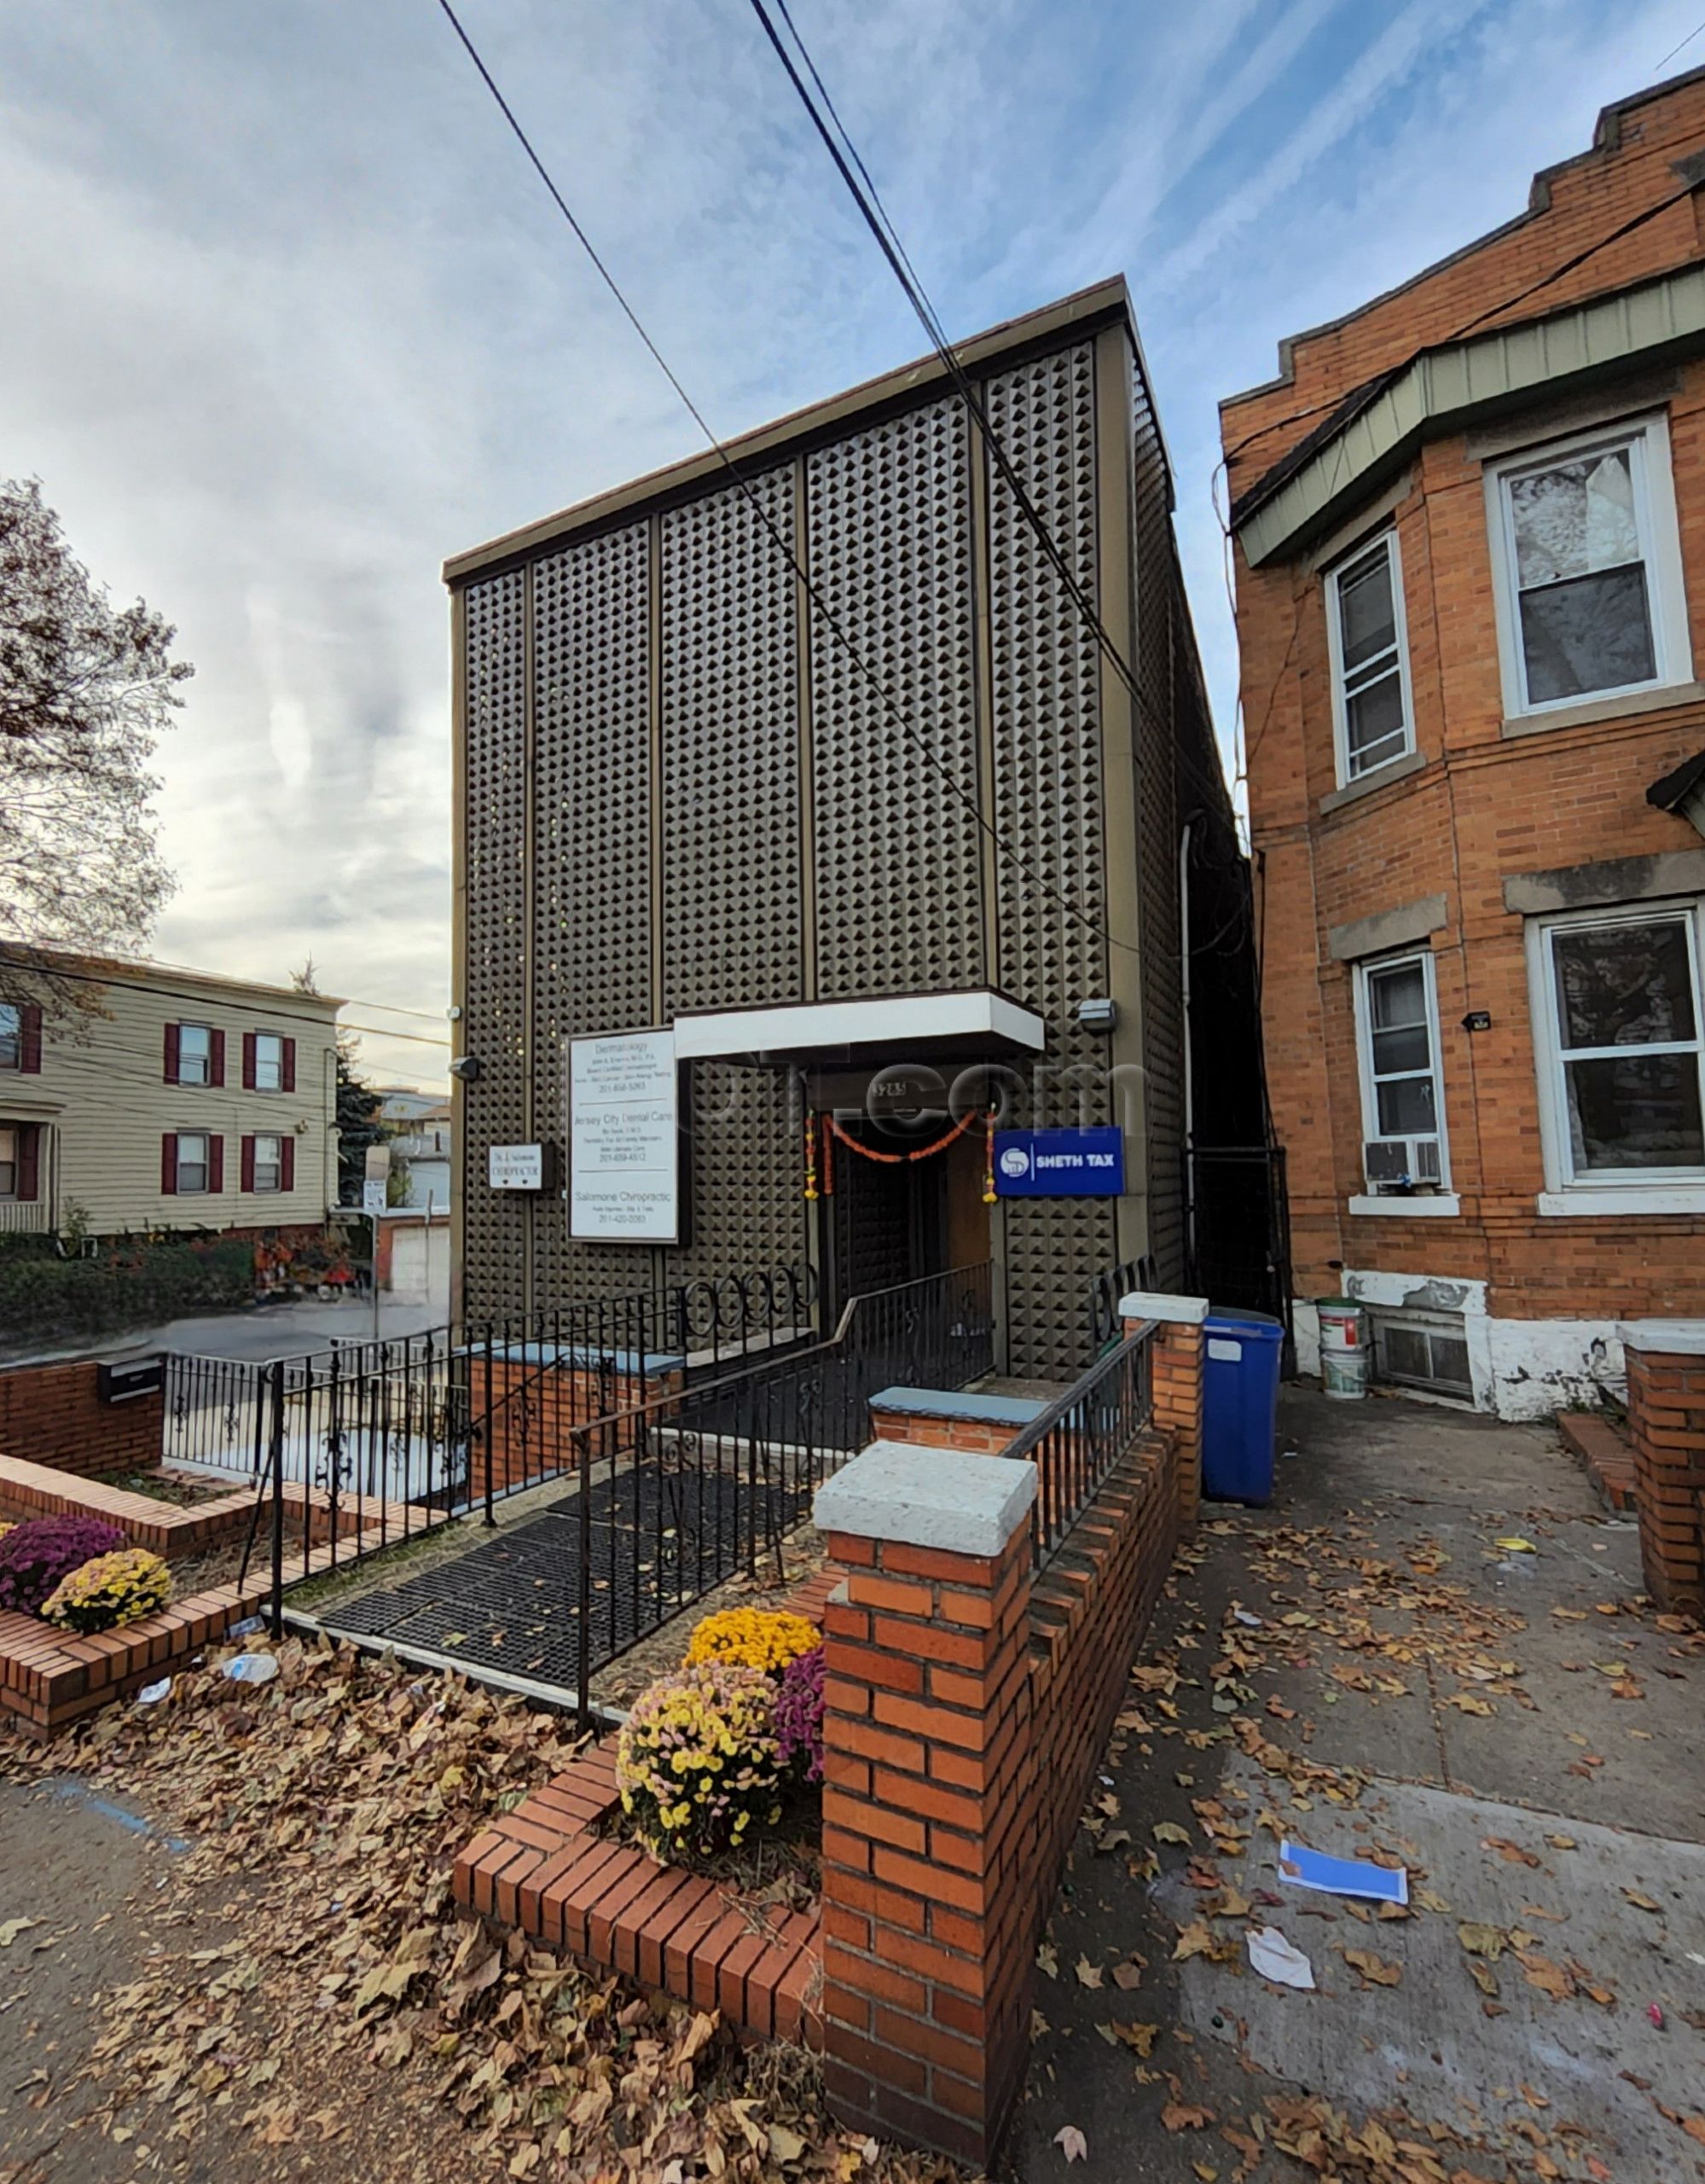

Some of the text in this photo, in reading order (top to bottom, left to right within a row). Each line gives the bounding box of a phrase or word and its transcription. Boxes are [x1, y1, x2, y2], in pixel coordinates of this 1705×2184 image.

[575, 1111, 672, 1125] Jersey City Dental Care
[1036, 1153, 1114, 1168] SHETH TAX
[619, 1191, 670, 1202] Chiropractic
